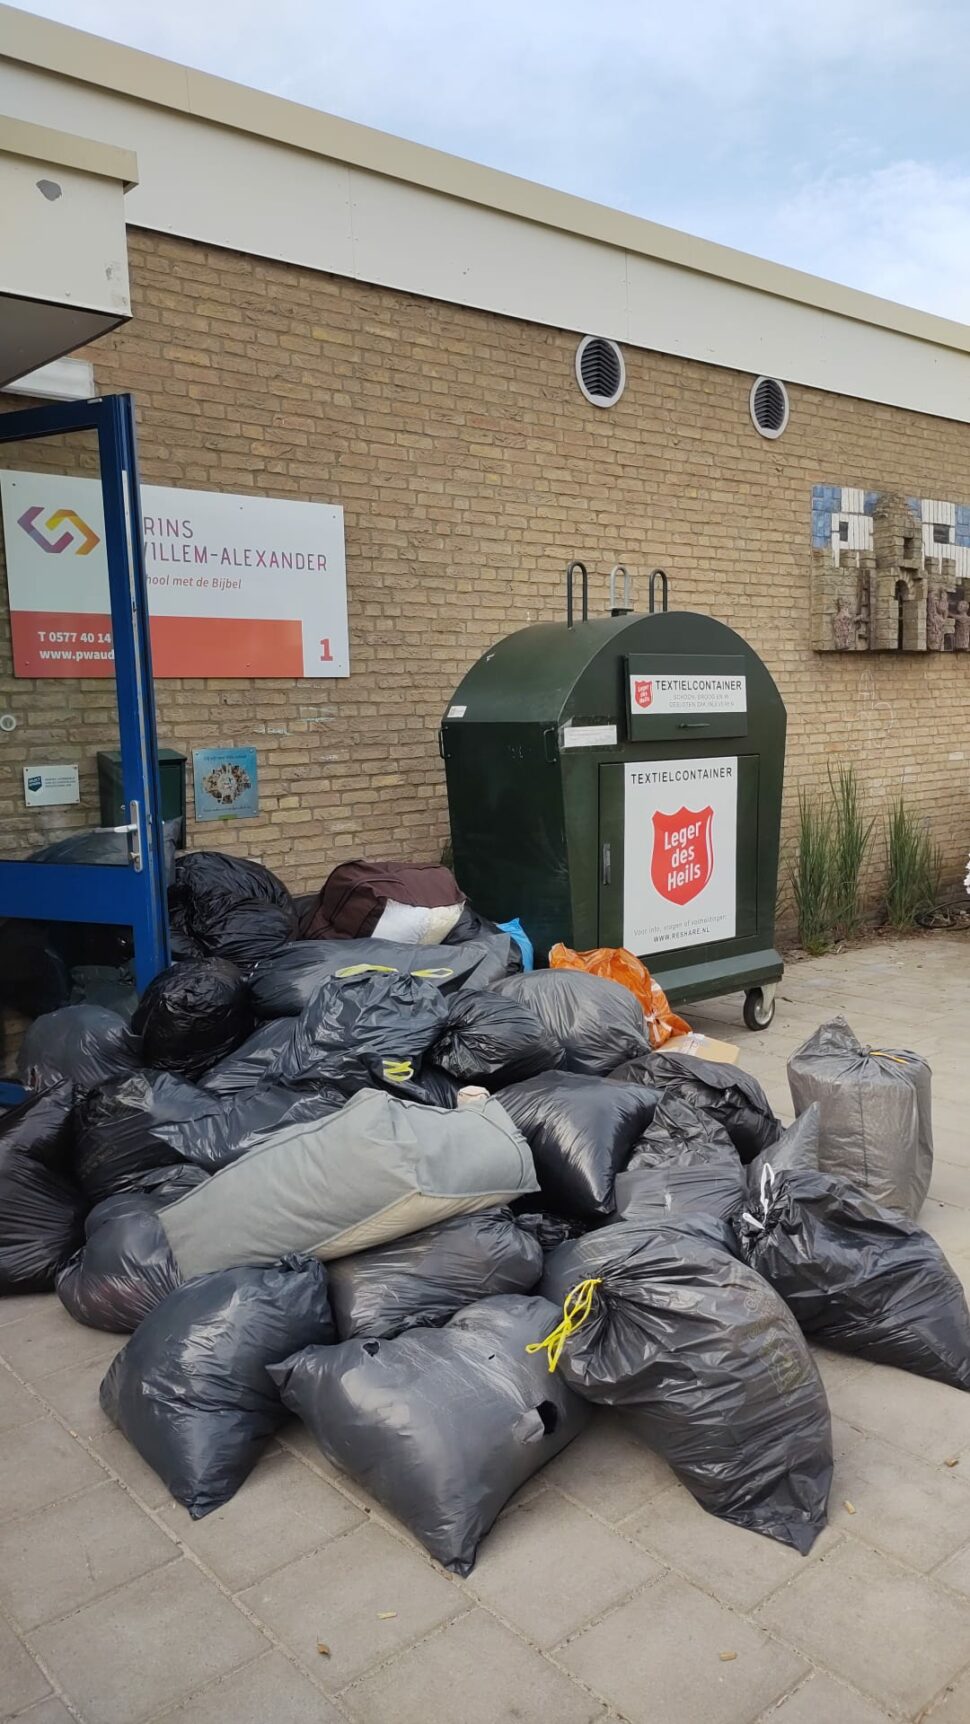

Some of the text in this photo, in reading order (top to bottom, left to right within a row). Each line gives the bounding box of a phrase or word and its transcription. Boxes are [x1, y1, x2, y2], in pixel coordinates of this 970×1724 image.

[143, 516, 194, 539] RINS
[143, 541, 327, 572] ILLEM-ALEXANDER
[146, 573, 242, 591] hool met de Bijbel
[37, 631, 112, 643] T 0577 40 14
[39, 649, 115, 662] www.pwaud
[319, 638, 334, 661] 1
[655, 680, 742, 691] TEXTIELCONTAINER
[630, 767, 733, 785] TEXTIELCONTAINER
[664, 820, 702, 851] Leger
[671, 847, 695, 869] des
[667, 862, 701, 892] Heils
[653, 926, 711, 942] WWW.RESHARE.NL
